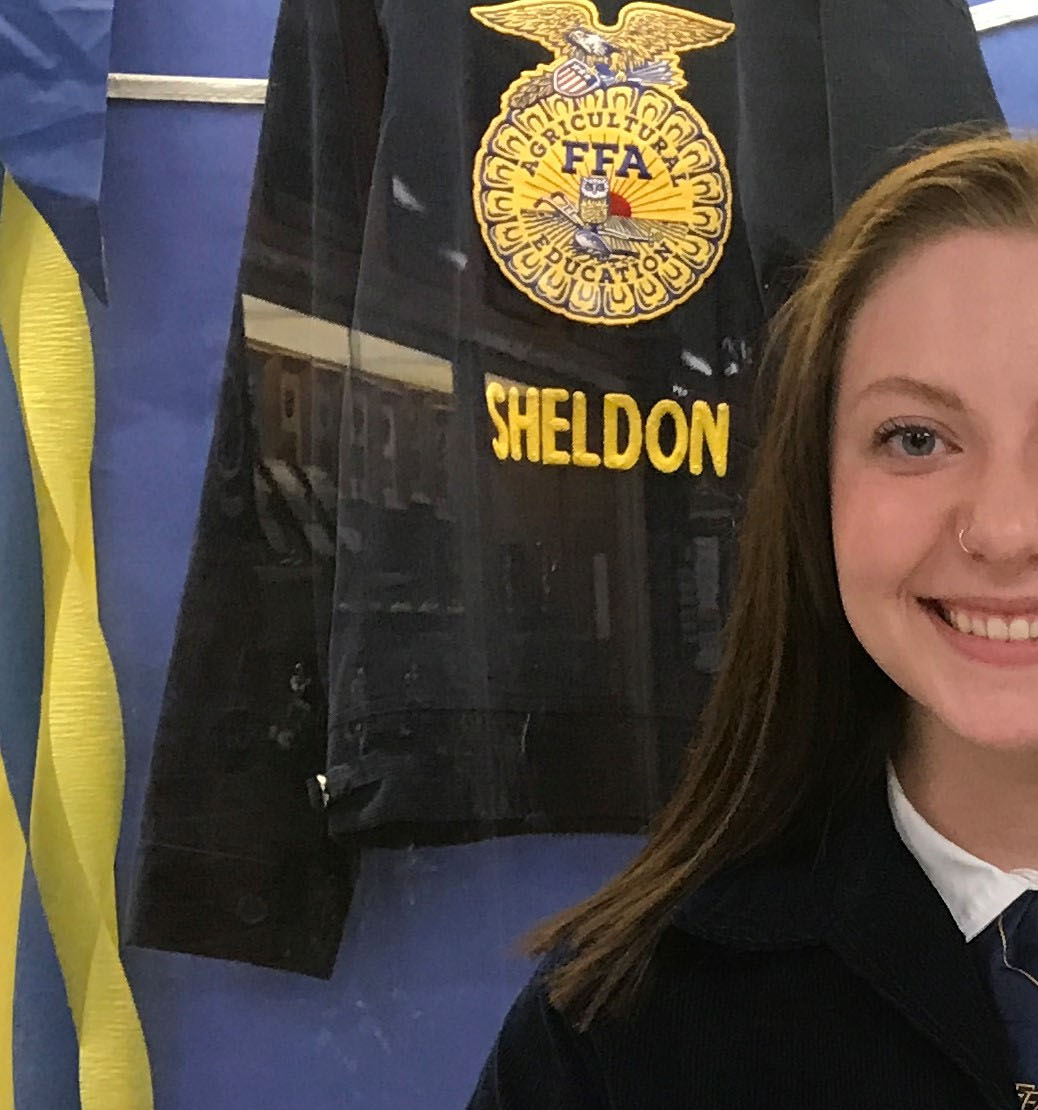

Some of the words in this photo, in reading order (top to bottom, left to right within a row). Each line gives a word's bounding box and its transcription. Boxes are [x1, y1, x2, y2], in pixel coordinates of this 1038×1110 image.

[519, 111, 690, 188] AGRICULTURAL
[561, 140, 653, 180] FFA
[530, 233, 679, 284] EDUCATION
[486, 382, 730, 477] SHELDON
